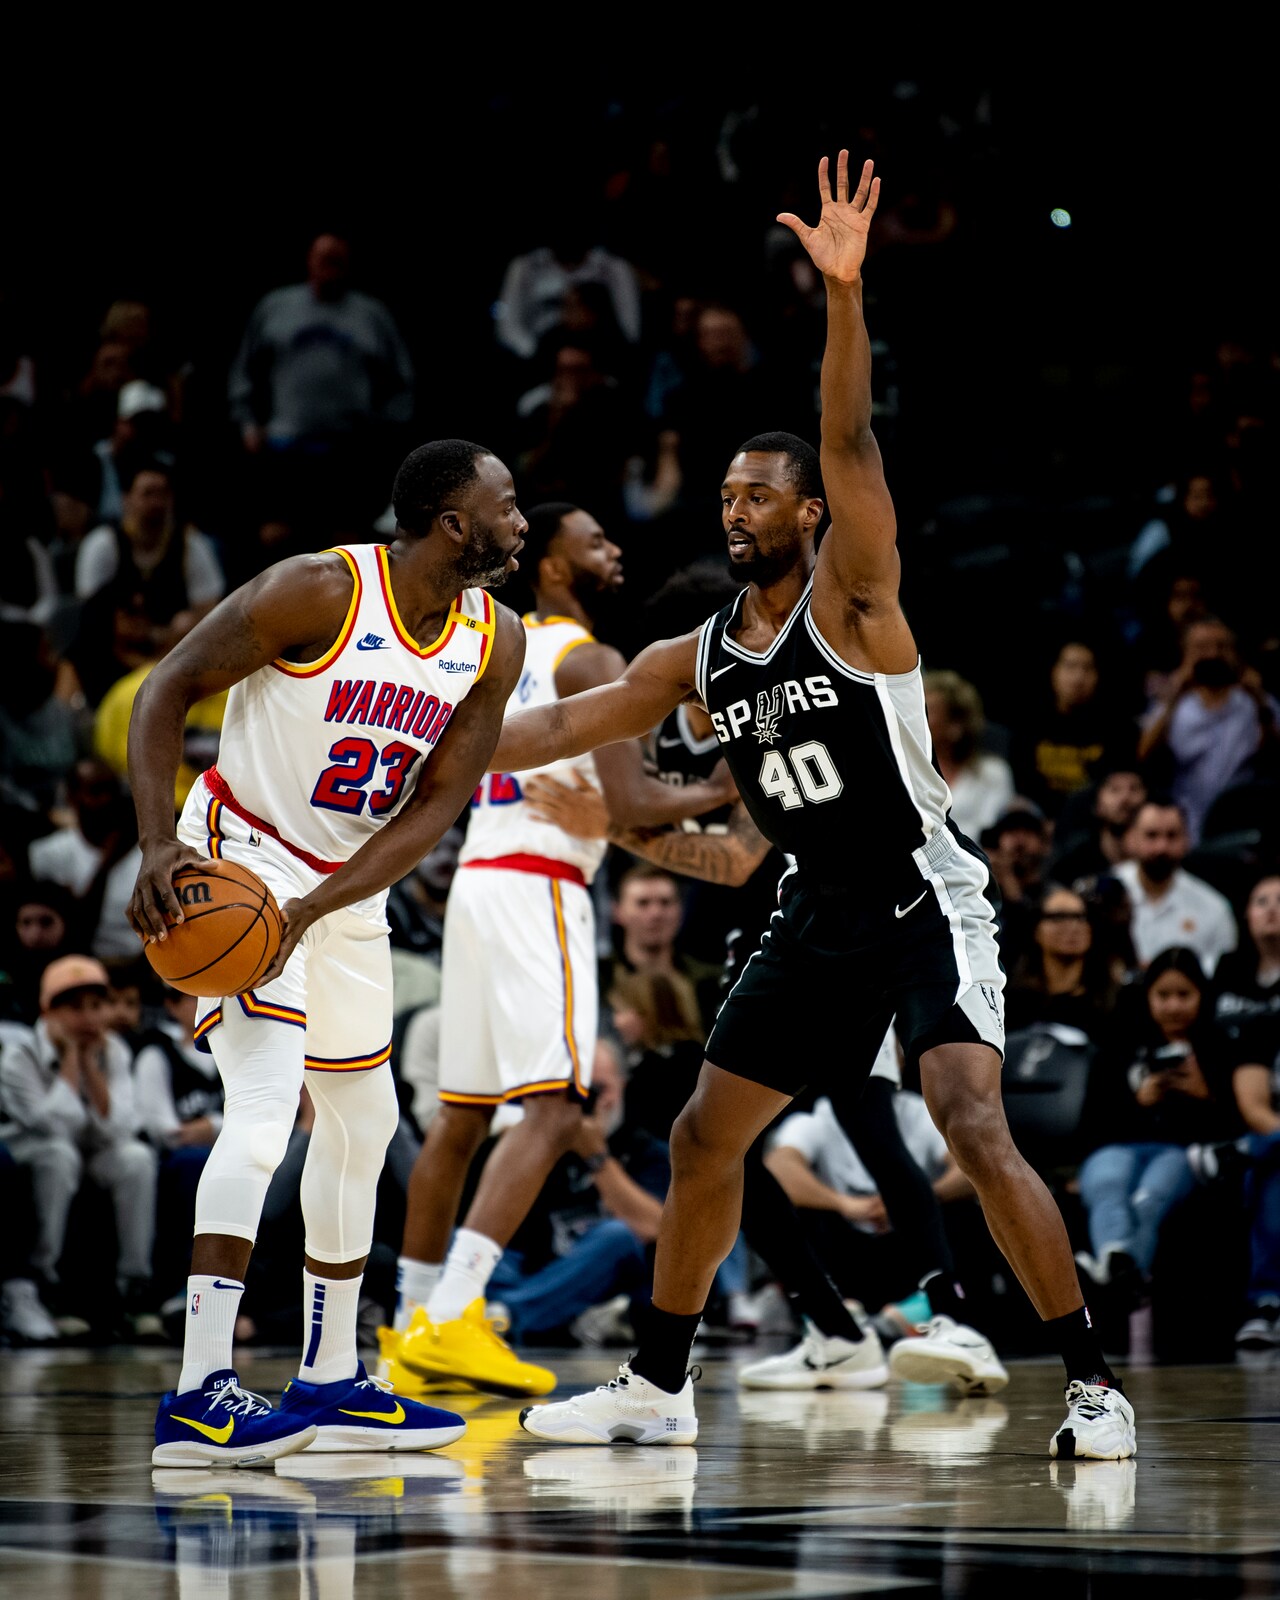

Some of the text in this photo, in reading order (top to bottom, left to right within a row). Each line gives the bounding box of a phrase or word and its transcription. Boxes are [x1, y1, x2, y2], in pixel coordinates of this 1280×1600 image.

[363, 632, 386, 647] NIKE
[465, 618, 477, 629] 16
[438, 659, 477, 673] Rakuten
[711, 675, 839, 745] SPURS
[310, 737, 423, 816] 23
[758, 740, 844, 811] 40
